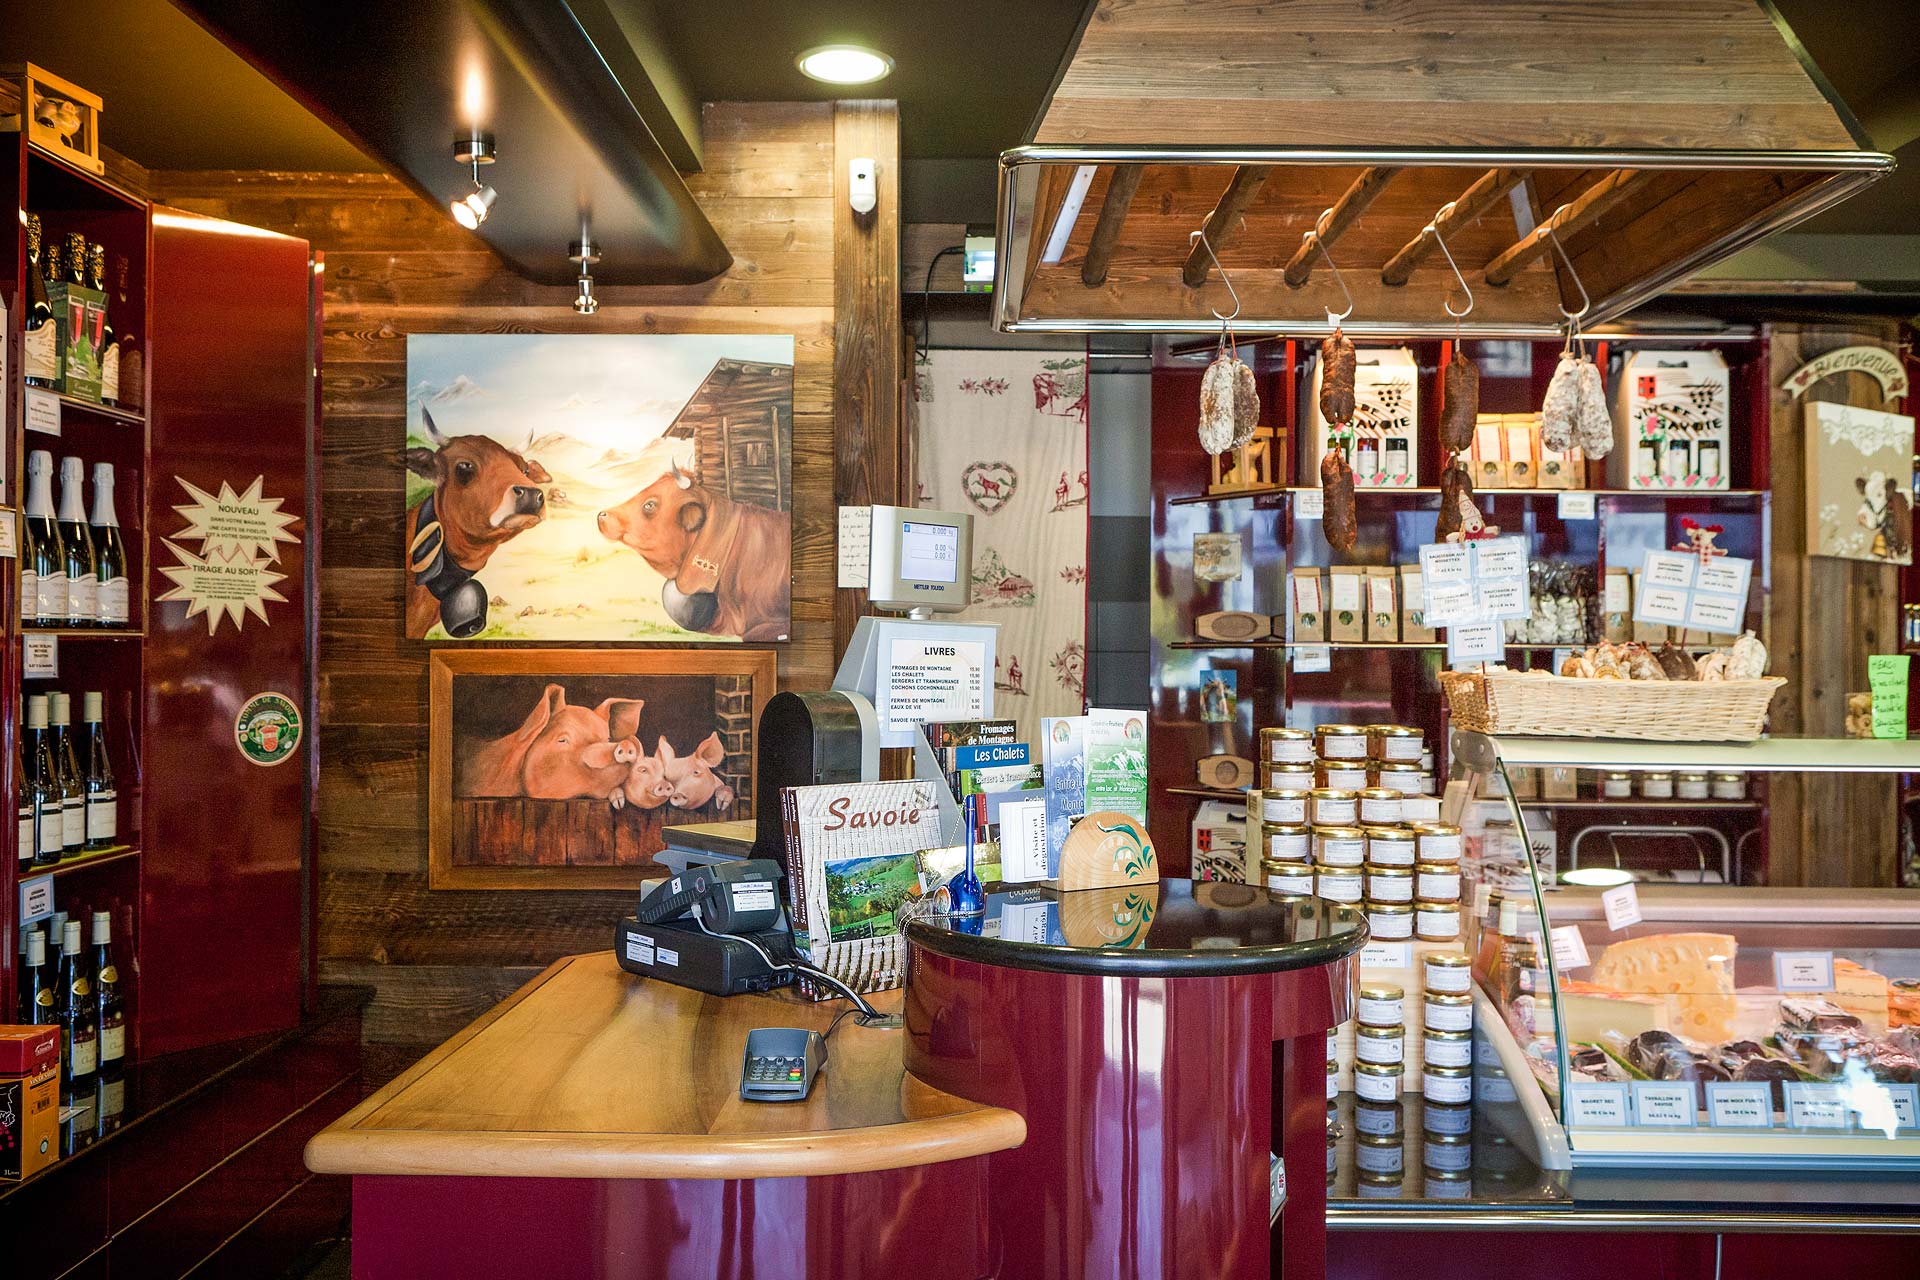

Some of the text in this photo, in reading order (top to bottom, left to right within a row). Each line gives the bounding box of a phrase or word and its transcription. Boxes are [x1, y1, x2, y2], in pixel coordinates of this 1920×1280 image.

[1814, 351, 1898, 379] Bienvenue
[1657, 418, 1722, 431] SAVOIE
[218, 505, 260, 516] NOUVEAU
[193, 565, 259, 576] TIRAGE AU SORT
[924, 647, 956, 656] LIVRES
[980, 724, 1015, 735] Fromages
[968, 735, 1015, 746] de Montagne
[974, 746, 1025, 762] Les Chalets
[1056, 777, 1075, 791] Entre
[823, 796, 921, 831] Savoie
[1194, 857, 1221, 873] VINS
